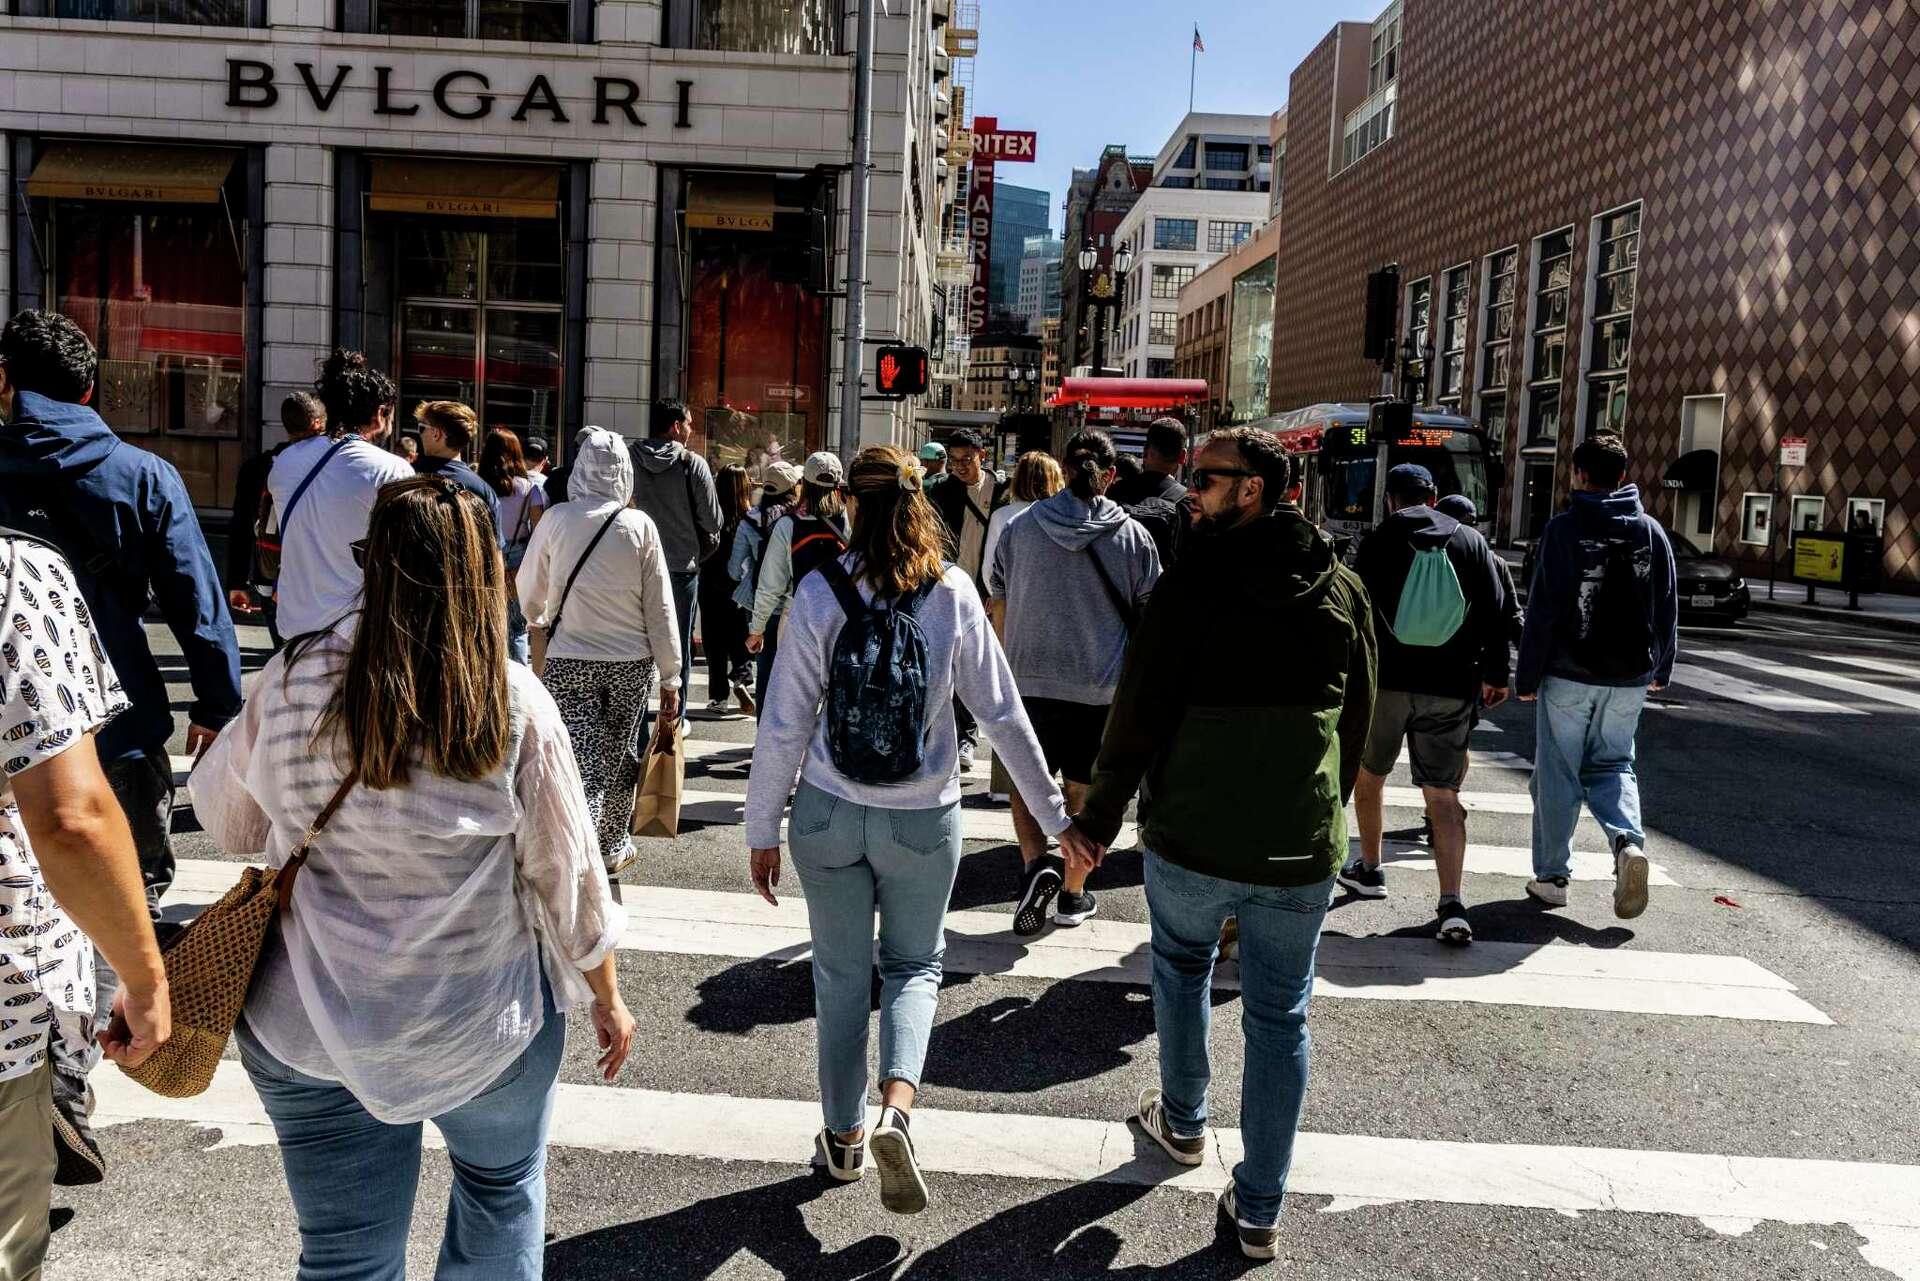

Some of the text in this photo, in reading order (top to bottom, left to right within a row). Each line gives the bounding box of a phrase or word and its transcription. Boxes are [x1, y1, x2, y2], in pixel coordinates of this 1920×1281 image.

[225, 58, 694, 128] BVLGARI
[86, 186, 163, 199] BVLGARI
[426, 199, 501, 213] BVLGARI
[716, 216, 771, 228] BVLGA
[969, 165, 992, 328] FABRICS
